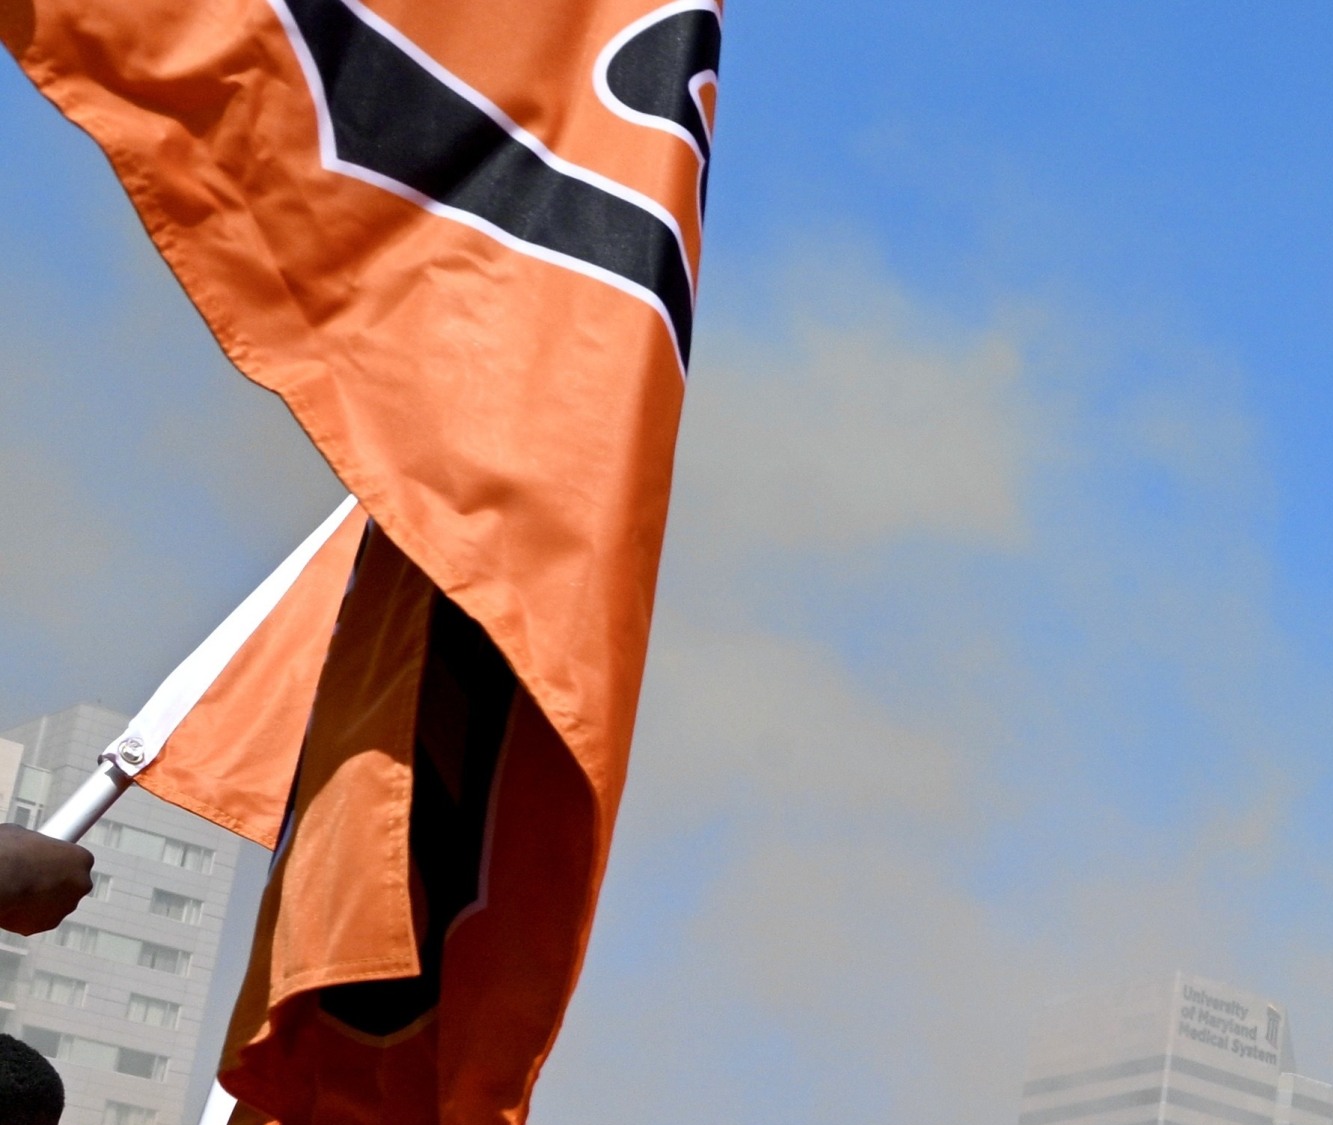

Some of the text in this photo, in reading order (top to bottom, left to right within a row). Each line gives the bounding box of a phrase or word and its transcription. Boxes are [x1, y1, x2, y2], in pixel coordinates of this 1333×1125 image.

[1183, 985, 1249, 1020] University
[1181, 1006, 1258, 1041] of Maryland
[1178, 1021, 1277, 1066] Medical System
